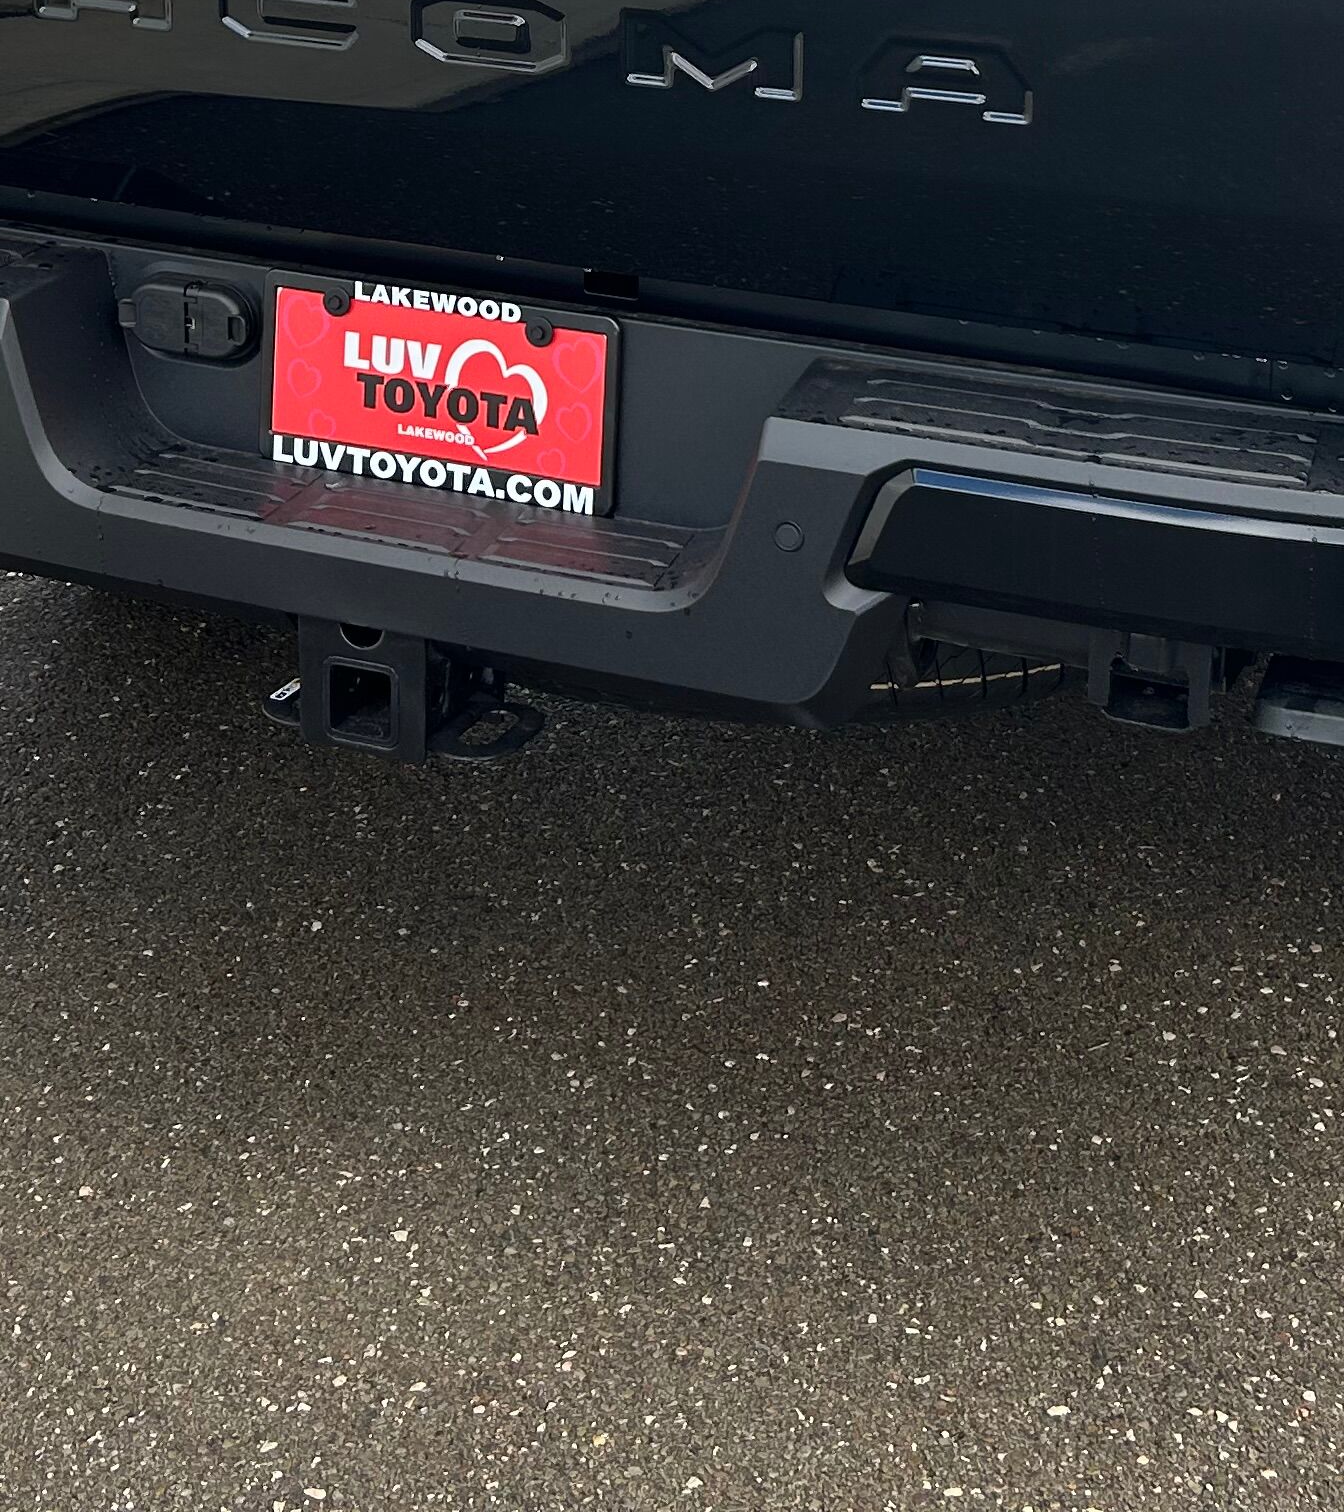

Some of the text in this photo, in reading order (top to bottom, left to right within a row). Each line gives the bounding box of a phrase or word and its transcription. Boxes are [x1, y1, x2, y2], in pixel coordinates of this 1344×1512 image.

[354, 280, 522, 324] LAKEWOOD
[343, 330, 442, 380] LUV
[356, 372, 540, 436] TOYOTA
[397, 423, 476, 447] LAKEWOOD
[272, 434, 594, 516] LUVTOYOTA.COM
